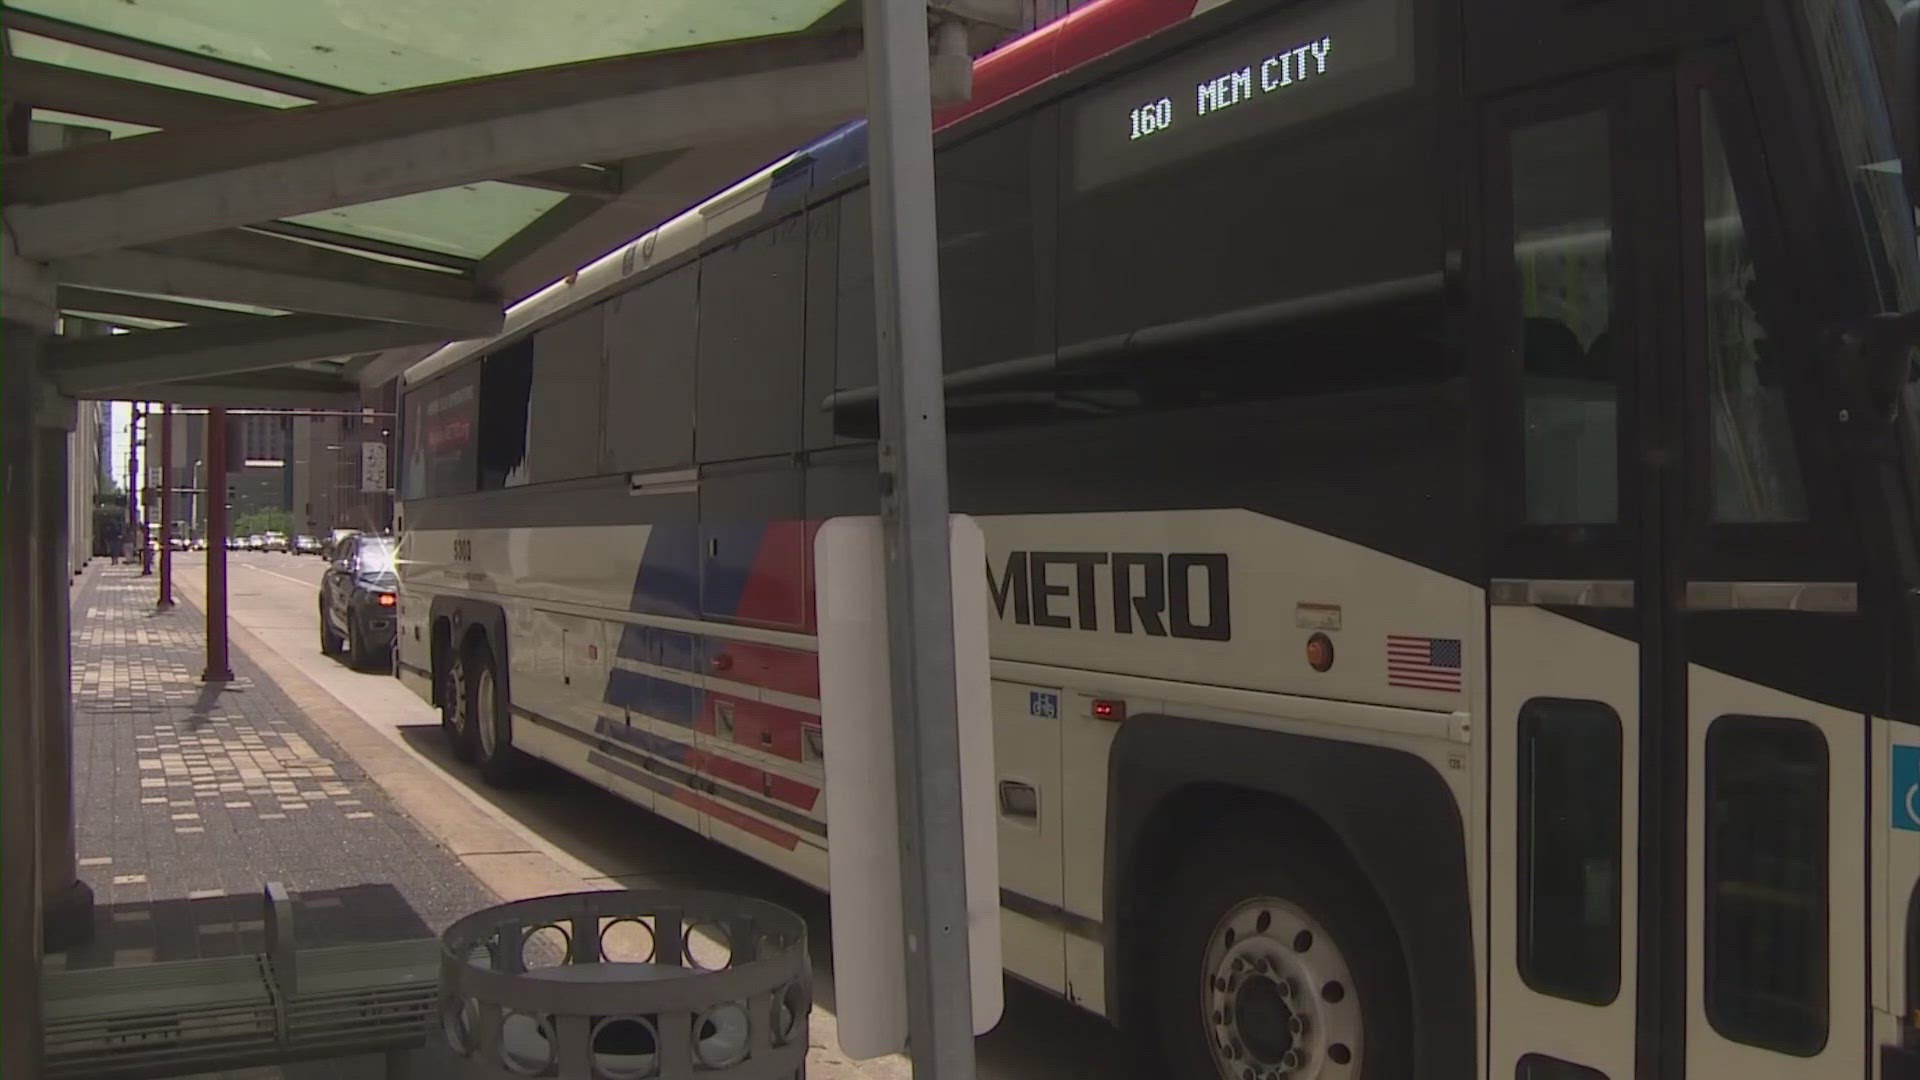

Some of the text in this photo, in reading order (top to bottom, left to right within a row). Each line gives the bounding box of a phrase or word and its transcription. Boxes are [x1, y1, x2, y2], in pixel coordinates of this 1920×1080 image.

[1130, 36, 1331, 140] 160 MEM CITY
[986, 551, 1231, 642] METRO
